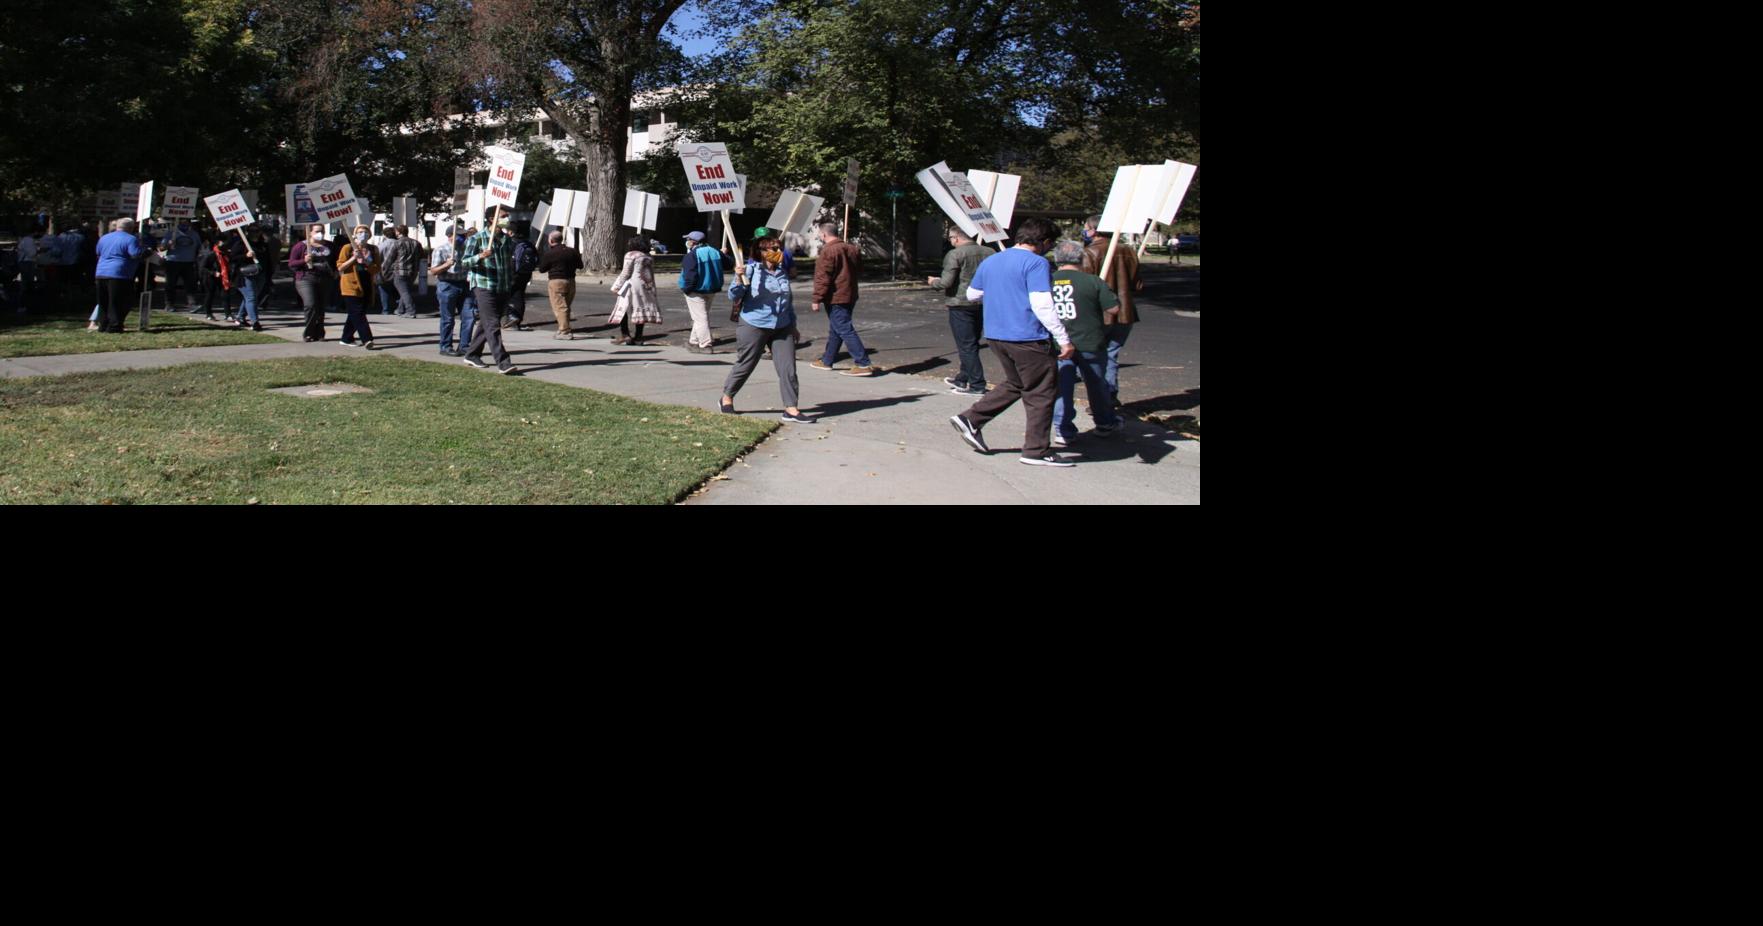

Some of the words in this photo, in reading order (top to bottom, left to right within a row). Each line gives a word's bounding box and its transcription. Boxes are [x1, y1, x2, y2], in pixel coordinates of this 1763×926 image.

[497, 166, 514, 181] End
[696, 164, 725, 179] End
[492, 186, 511, 200] Now!
[692, 182, 718, 191] Unpaid
[719, 181, 738, 189] Work
[171, 196, 190, 204] End
[320, 189, 344, 203] End
[703, 191, 735, 205] Now!
[961, 194, 982, 209] End
[218, 201, 239, 214] End
[326, 205, 353, 219] Now!
[224, 215, 247, 227] Now!
[1053, 285, 1074, 302] 32
[1055, 302, 1077, 320] 99
